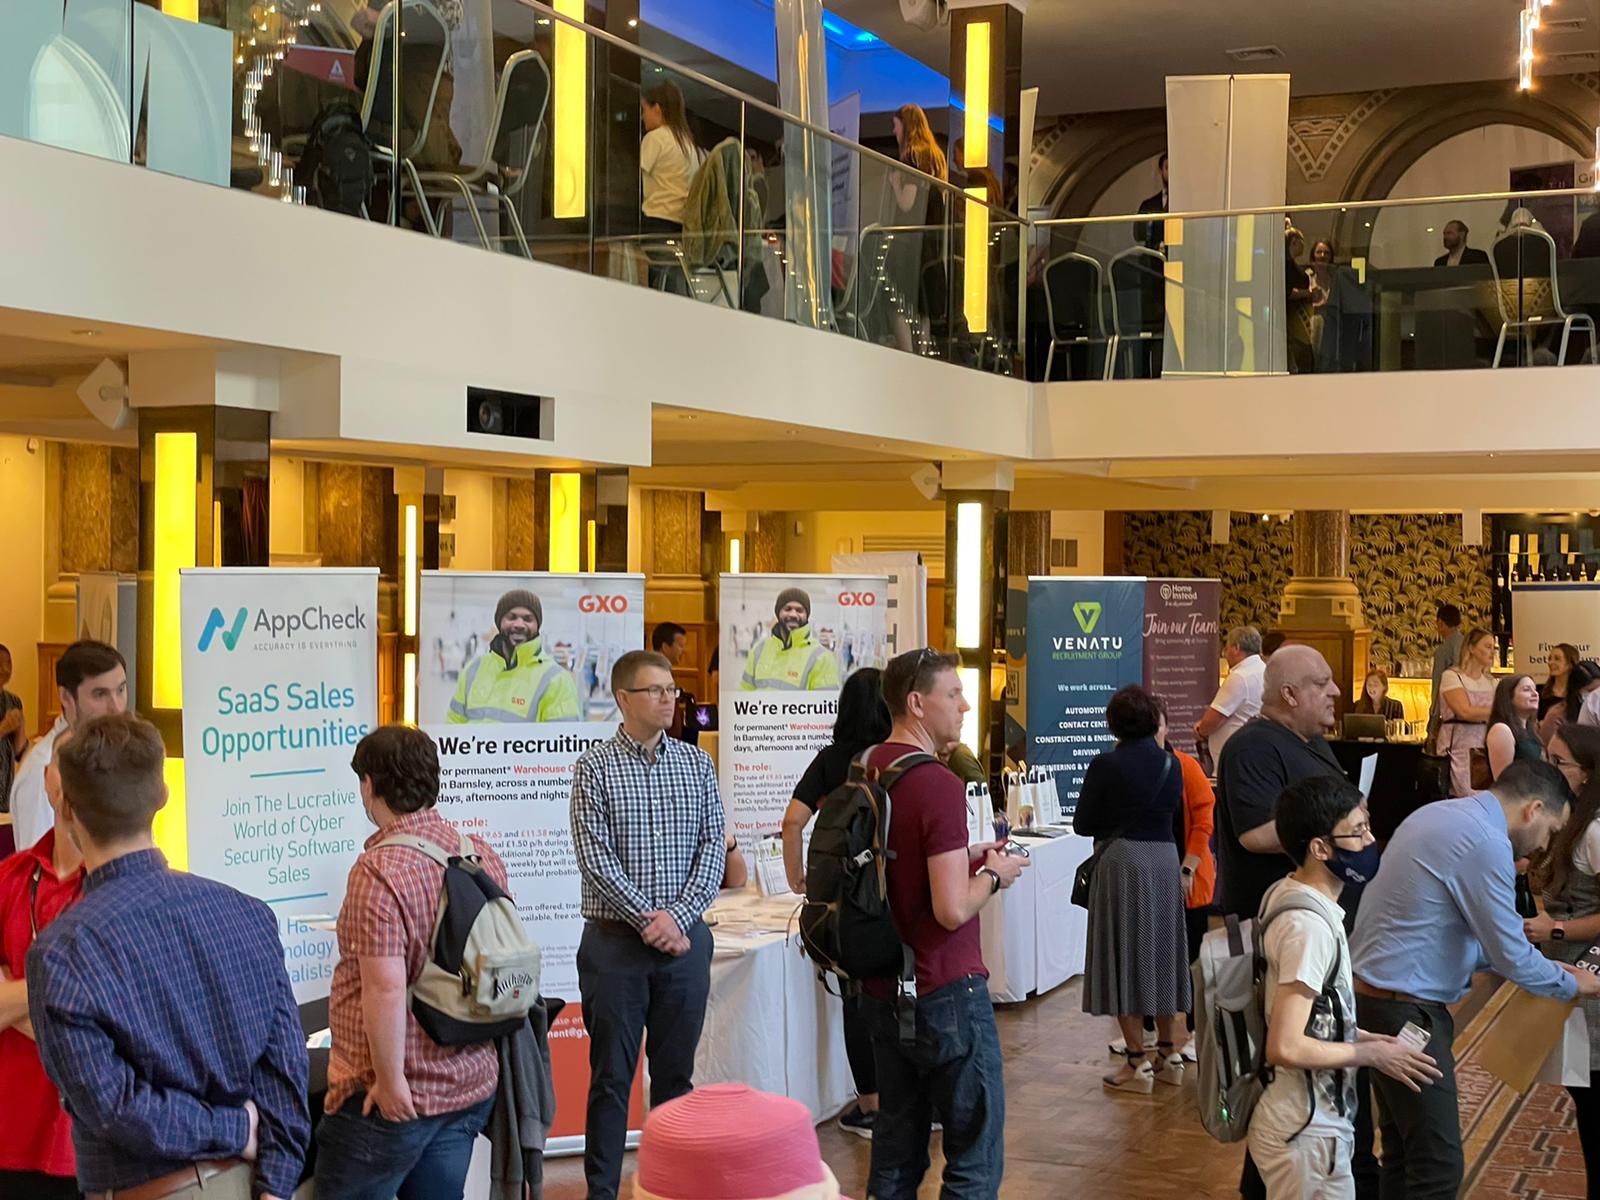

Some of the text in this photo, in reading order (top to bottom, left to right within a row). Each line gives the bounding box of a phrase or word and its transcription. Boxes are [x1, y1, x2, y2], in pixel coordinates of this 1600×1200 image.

[1172, 584, 1193, 593] Home
[838, 592, 876, 606] GXO
[1172, 592, 1198, 600] Instead
[578, 595, 628, 614] GXO
[253, 605, 367, 638] AppCheck
[1142, 612, 1217, 638] Join our Team
[254, 640, 358, 651] ACCURACY IS EVERYTHING
[1052, 636, 1123, 650] VENATU
[1051, 650, 1123, 660] RECRUITMENT GROUP
[1057, 684, 1069, 692] We
[1070, 683, 1088, 692] work
[218, 681, 355, 716] SaaS Sales
[734, 699, 839, 715] We're recruiti
[1065, 706, 1107, 715] AUTOMOTIV
[733, 723, 745, 732] for
[1058, 720, 1109, 729] CONTACT CENT
[202, 718, 369, 763] Opportunities
[742, 734, 775, 743] Barnsley,
[807, 732, 832, 741] numbe
[1035, 736, 1086, 744] CONSTRUCTION
[1094, 734, 1117, 742] ENGIN
[438, 736, 497, 756] We're
[733, 744, 753, 753] days,
[754, 744, 794, 752] afternoons
[795, 743, 809, 751] and
[1072, 748, 1101, 757] DRIVING
[513, 764, 567, 774] Warehouse
[734, 763, 750, 772] The
[449, 779, 494, 790] Barnsley,
[495, 780, 528, 788] across
[437, 790, 570, 804] days, afternoons and nights
[222, 788, 356, 818] Join The Lucrative
[462, 816, 488, 828] role:
[734, 821, 755, 830] Your
[233, 815, 345, 841] World of Cyber
[504, 830, 519, 838] and
[549, 827, 568, 838] night
[506, 839, 528, 849] £1.50
[544, 838, 569, 847] during
[224, 838, 356, 866] Security Software
[500, 848, 534, 858] dditional
[535, 848, 550, 858] 70p
[510, 860, 537, 868] weekly
[539, 859, 552, 867] but
[267, 866, 311, 885] Sales
[545, 868, 580, 877] probatio
[554, 911, 570, 920] free
[285, 939, 334, 960] nology
[288, 963, 332, 983] alists
